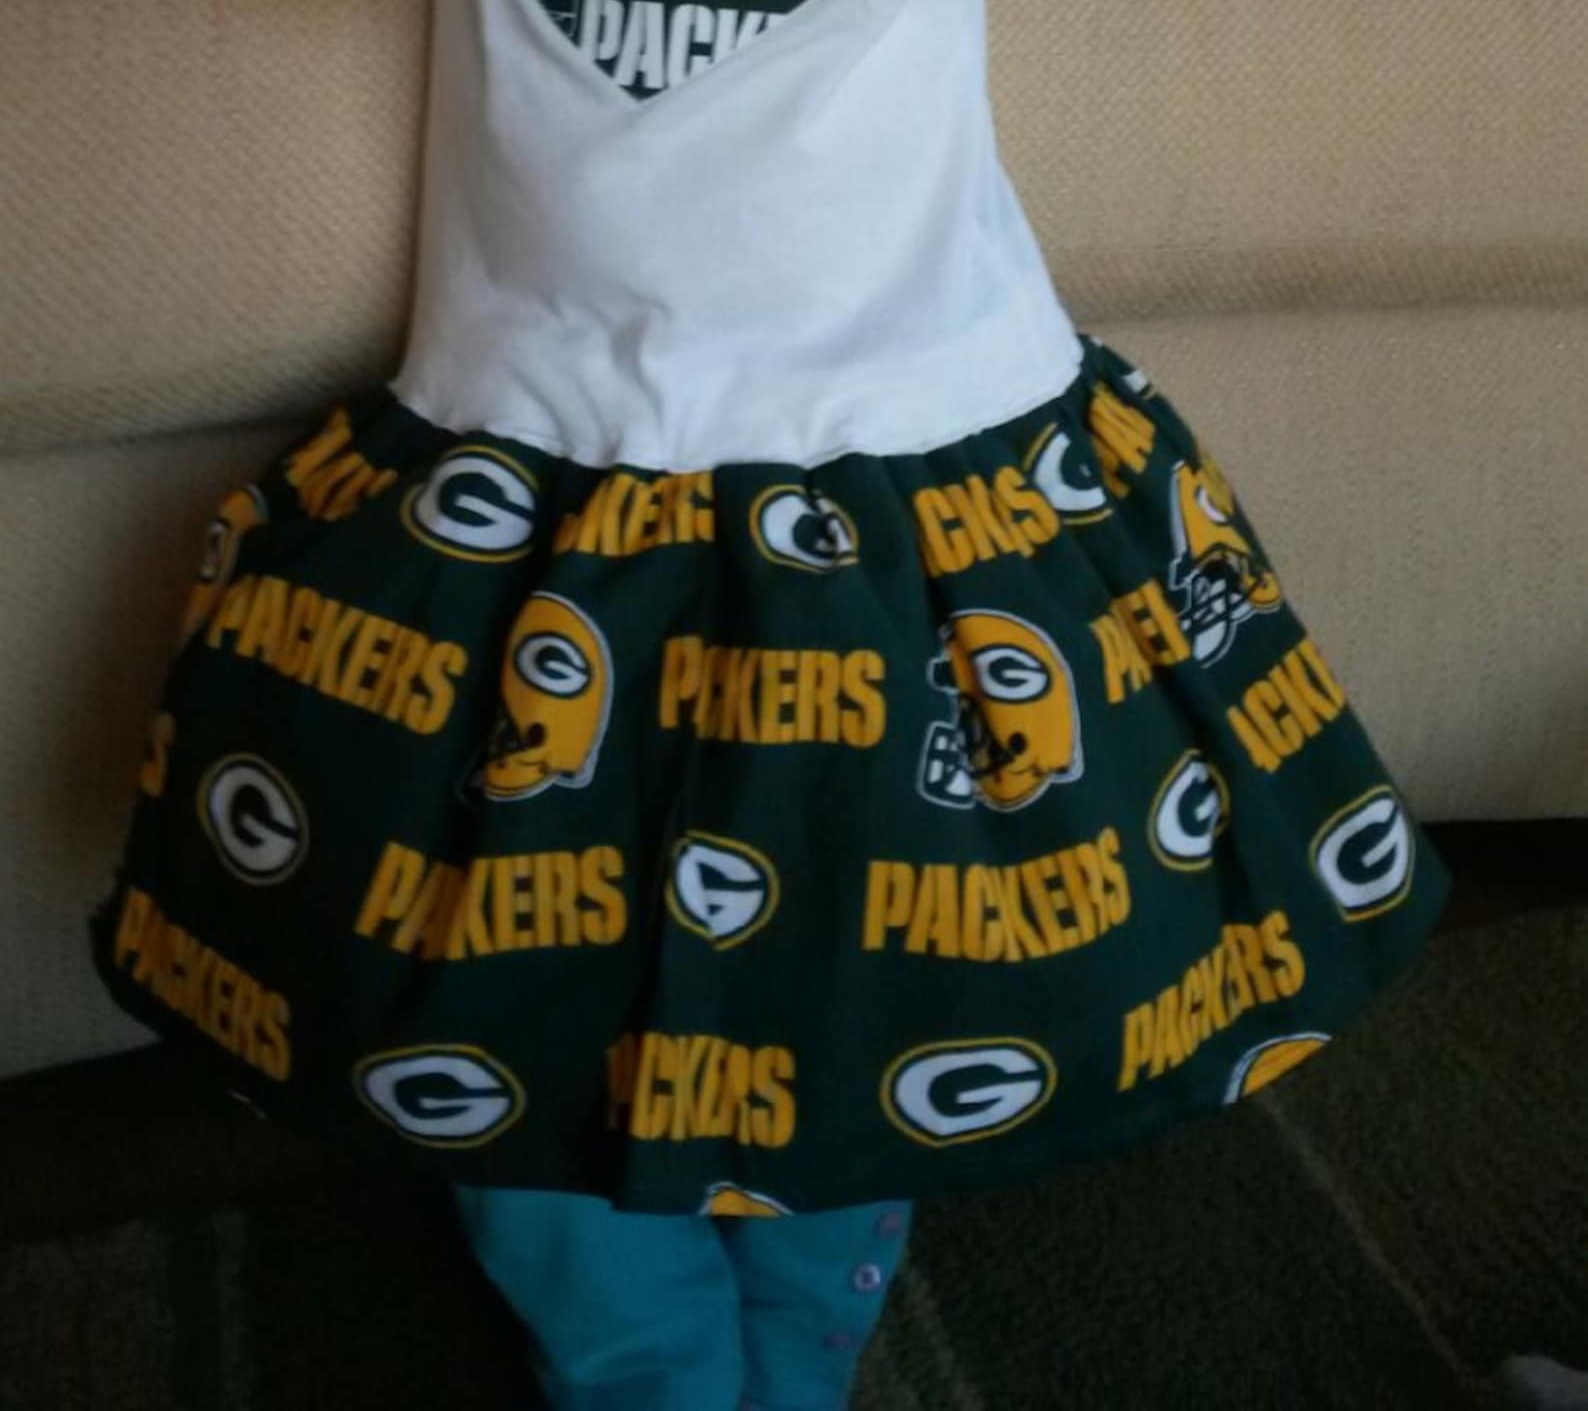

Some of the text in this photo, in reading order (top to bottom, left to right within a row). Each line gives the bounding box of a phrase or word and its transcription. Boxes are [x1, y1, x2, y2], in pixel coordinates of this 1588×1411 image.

[412, 456, 536, 551] G
[518, 635, 590, 696] G
[975, 646, 1048, 702] G
[209, 766, 300, 878] G
[1315, 797, 1411, 908] G
[862, 826, 1132, 964] PACKERS
[364, 1056, 512, 1138] G
[895, 1047, 1043, 1136] G
